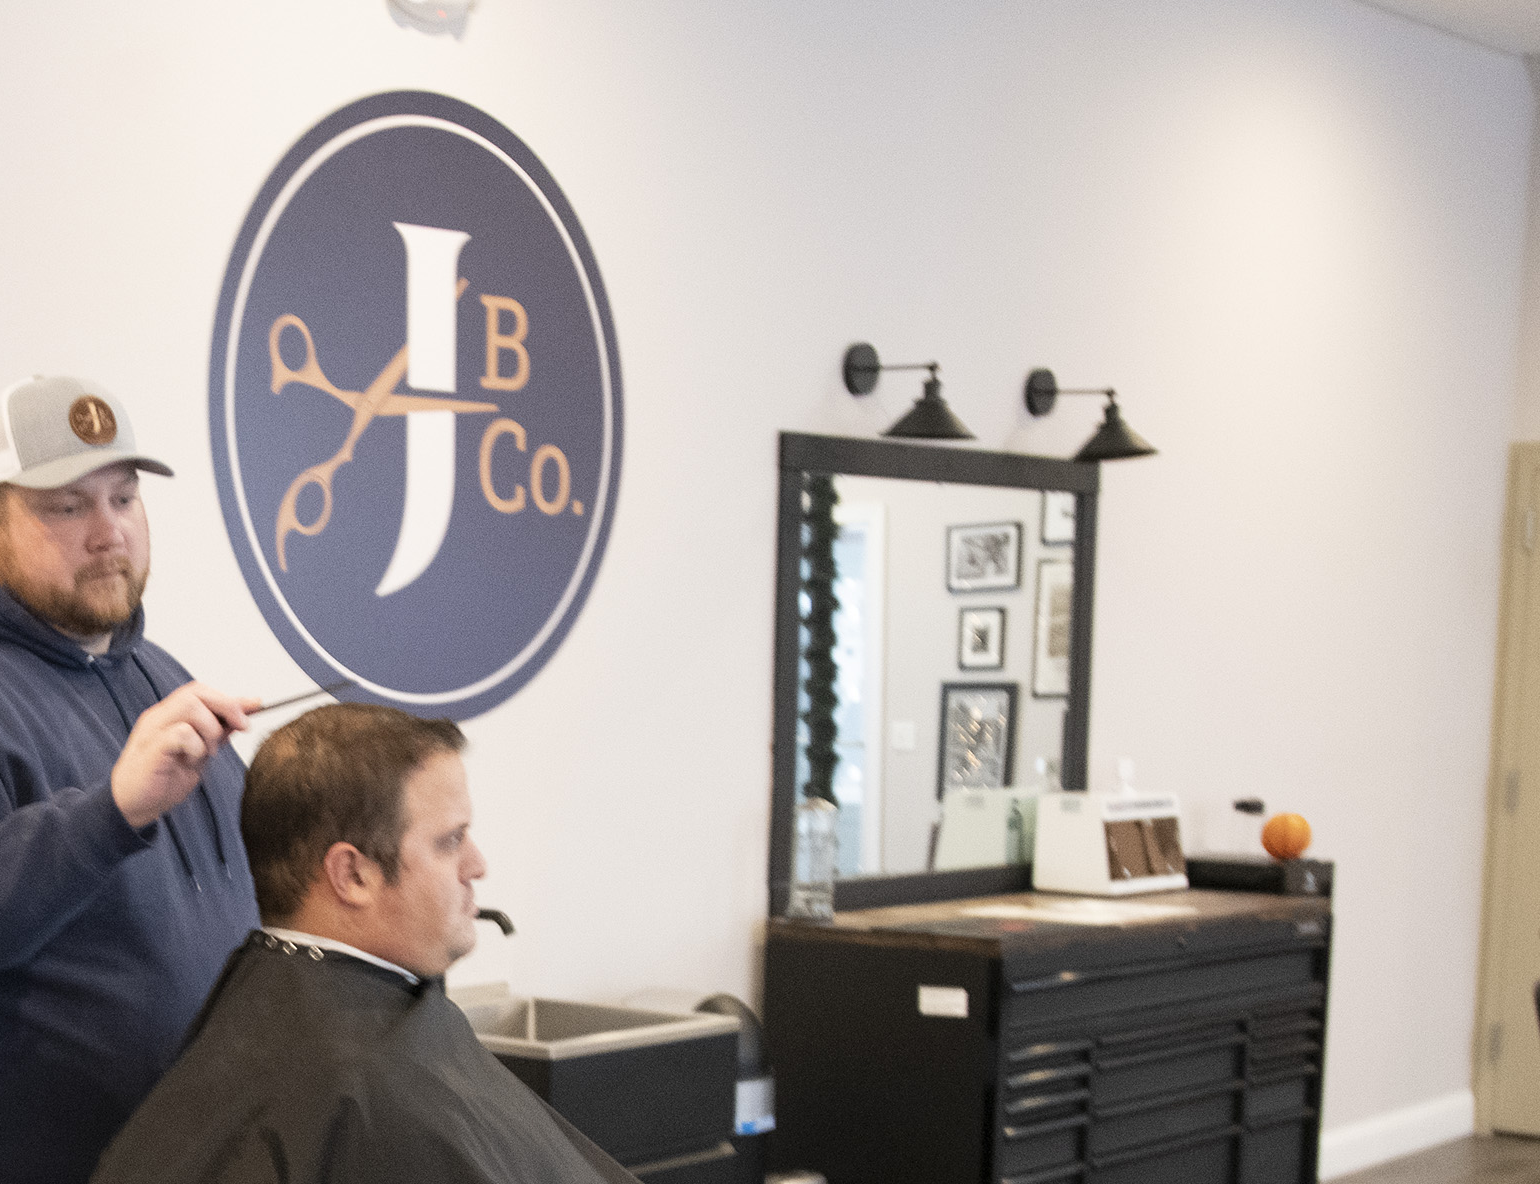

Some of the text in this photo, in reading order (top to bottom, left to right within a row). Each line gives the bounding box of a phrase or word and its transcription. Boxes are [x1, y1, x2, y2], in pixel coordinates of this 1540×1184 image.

[480, 295, 531, 392] B
[376, 222, 471, 597] J
[478, 417, 584, 516] Co.
